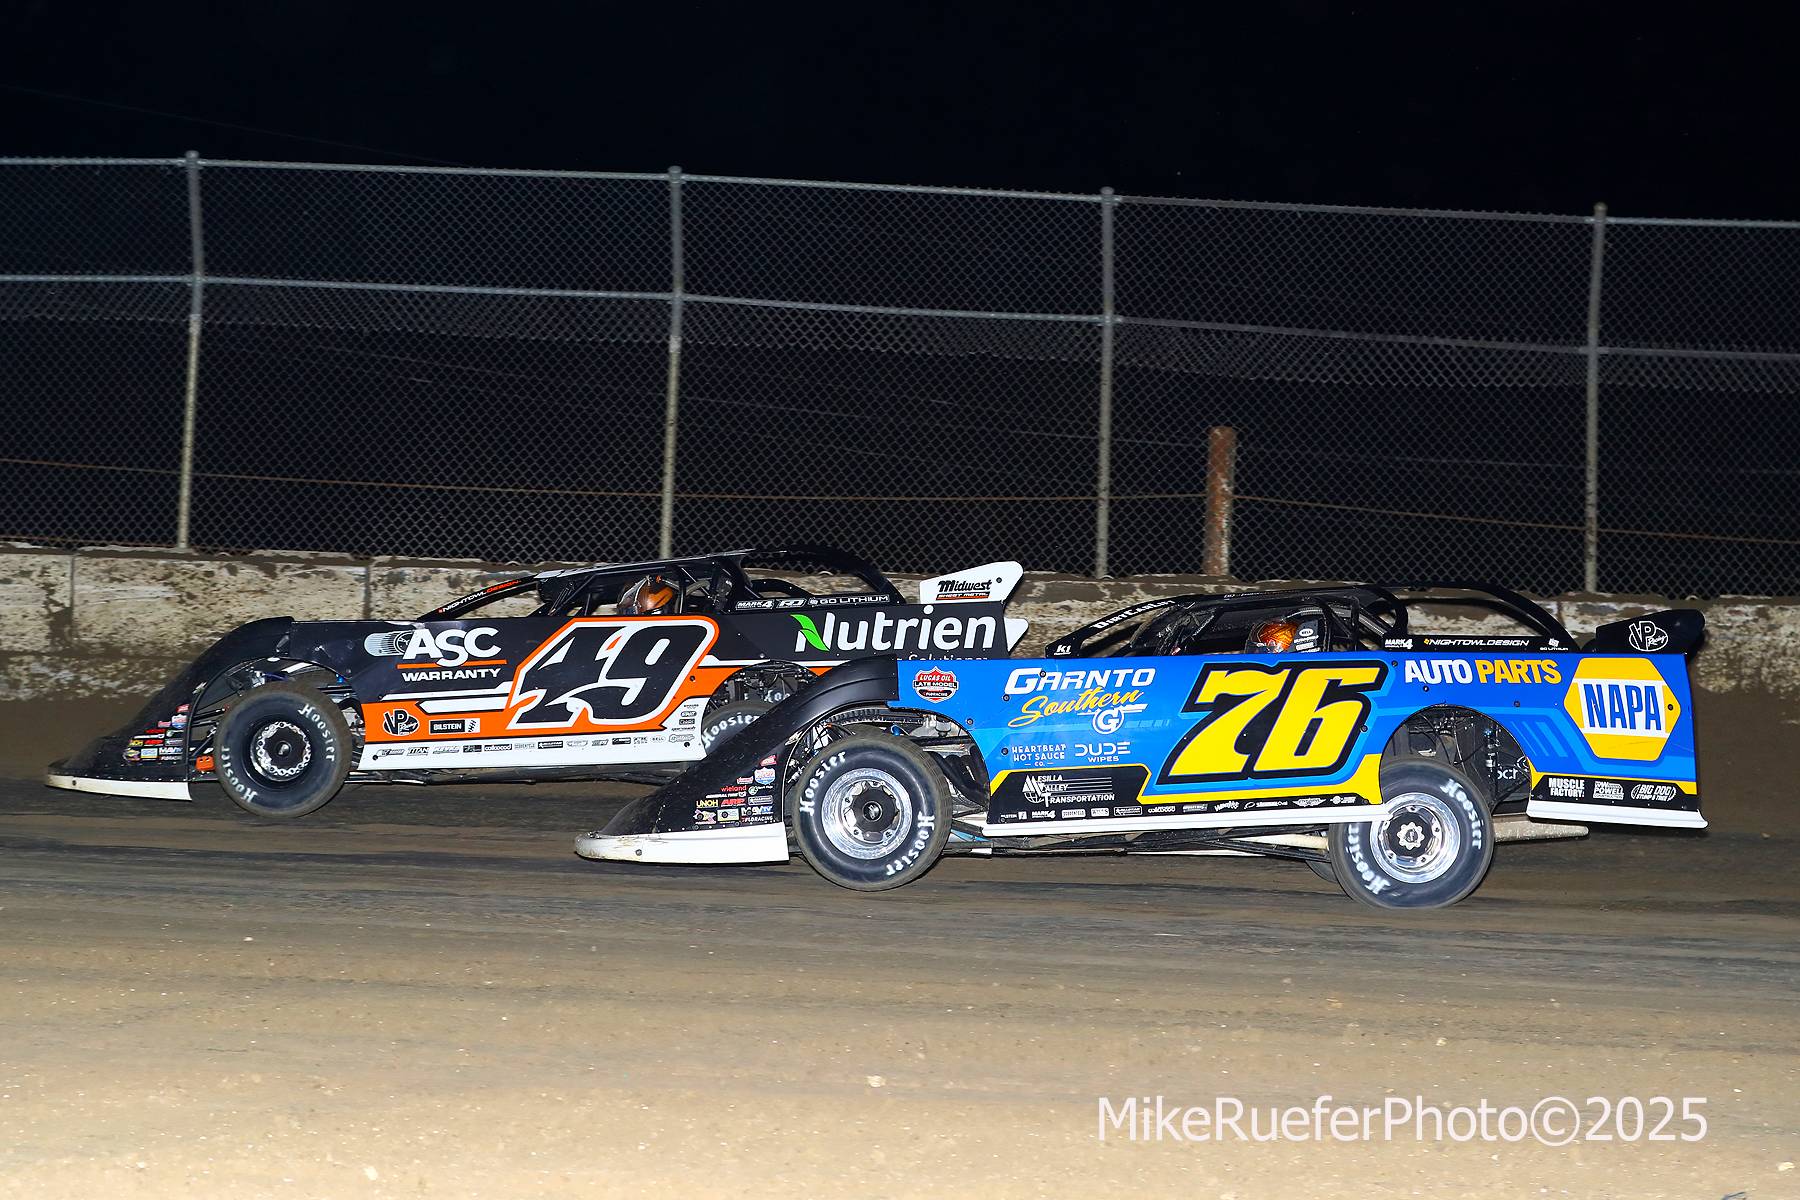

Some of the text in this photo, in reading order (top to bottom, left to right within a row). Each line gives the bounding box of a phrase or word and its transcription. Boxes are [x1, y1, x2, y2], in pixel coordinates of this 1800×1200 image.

[840, 596, 889, 604] LITHIUM
[938, 579, 992, 592] Midwest
[789, 604, 997, 653] Nutrien
[402, 627, 502, 667] ASC
[402, 668, 501, 682] WARRANTY
[513, 622, 710, 726] 49
[1004, 667, 1156, 695] GARNTO
[1405, 659, 1563, 685] AUTO PARTS
[1007, 686, 1146, 728] Southern
[1160, 660, 1387, 785] 76
[1583, 684, 1662, 731] NAPA
[298, 703, 337, 762] Hoosier
[433, 722, 462, 731] BILSTEIN
[702, 711, 761, 750] Hoosier
[1012, 744, 1067, 754] HEARTBEAT
[1013, 750, 1065, 762] HOT SAUCE
[1074, 741, 1131, 757] DUDE
[1087, 755, 1120, 763] WIPES
[221, 746, 259, 803] Hoosier
[800, 751, 846, 816] Hoosier
[1548, 778, 1585, 789] MUSCLE
[1640, 784, 1672, 796] BIG DOG
[1041, 793, 1115, 807] TRANSPORTATION
[1439, 778, 1485, 850] Hoosier
[886, 811, 935, 876] Hoosier
[1346, 824, 1391, 895] Hoosier
